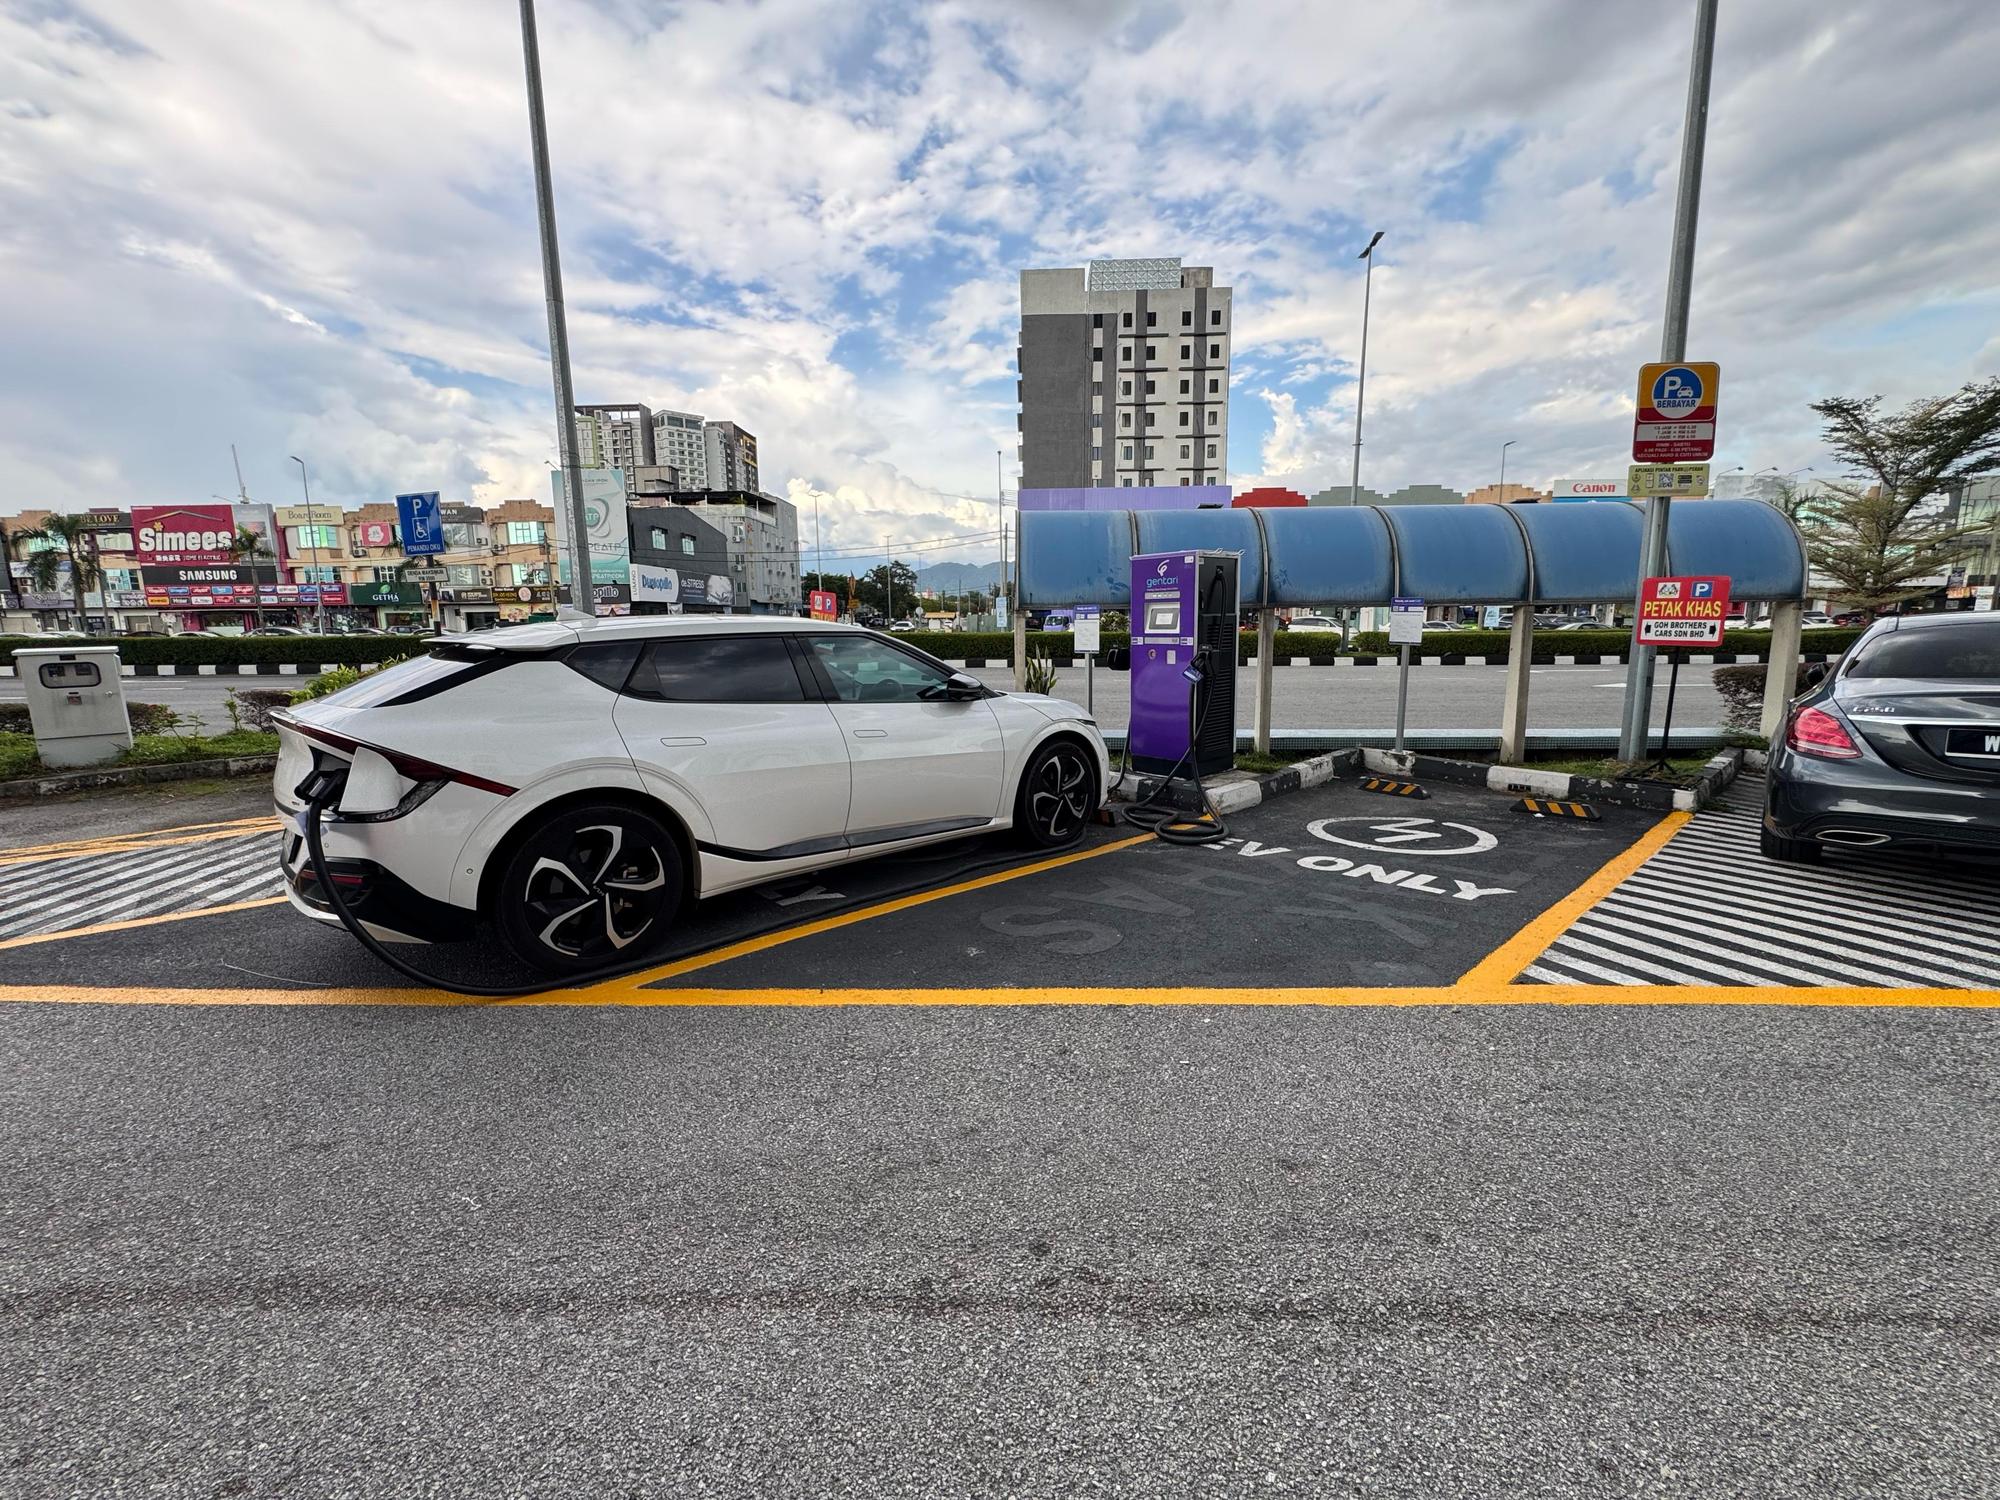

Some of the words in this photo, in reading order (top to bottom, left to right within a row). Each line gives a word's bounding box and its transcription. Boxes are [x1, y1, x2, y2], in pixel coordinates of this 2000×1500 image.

[1657, 400, 1696, 408] BERBAYAR
[1572, 483, 1616, 493] Canon
[412, 498, 422, 517] P
[139, 526, 232, 552] Simees
[430, 543, 441, 551] OKU
[179, 570, 238, 581] SAMSUNG
[1146, 576, 1179, 588] gentari
[1695, 583, 1709, 597] P
[1643, 600, 1684, 617] PETAK
[1685, 600, 1722, 617] KHAS
[1654, 621, 1669, 629] GOH
[1670, 621, 1707, 629] BROTHERS
[1689, 630, 1704, 638] BHD
[1296, 855, 1517, 901] ONLY
